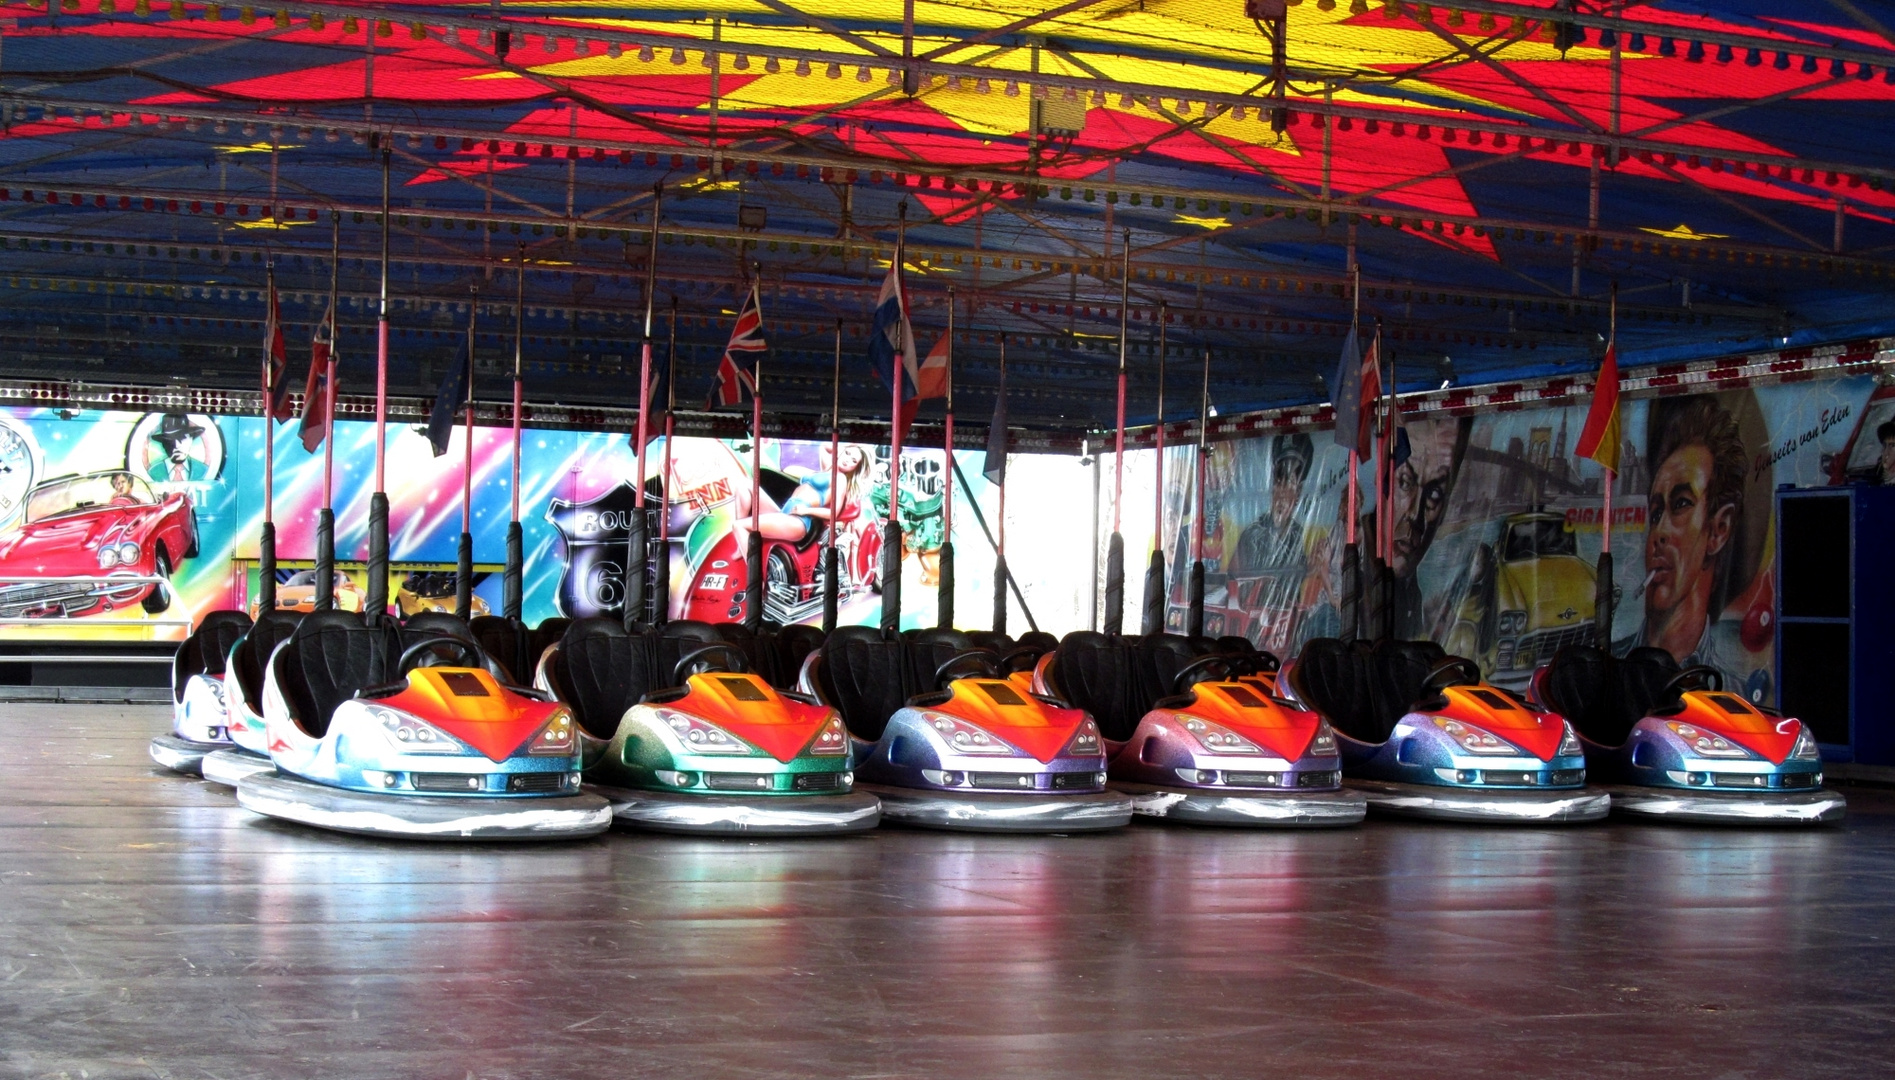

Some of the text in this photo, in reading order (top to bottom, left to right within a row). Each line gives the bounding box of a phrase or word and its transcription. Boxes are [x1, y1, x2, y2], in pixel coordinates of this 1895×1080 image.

[1799, 427, 1819, 446] von
[1821, 406, 1850, 435] Eden
[685, 477, 732, 510] INN
